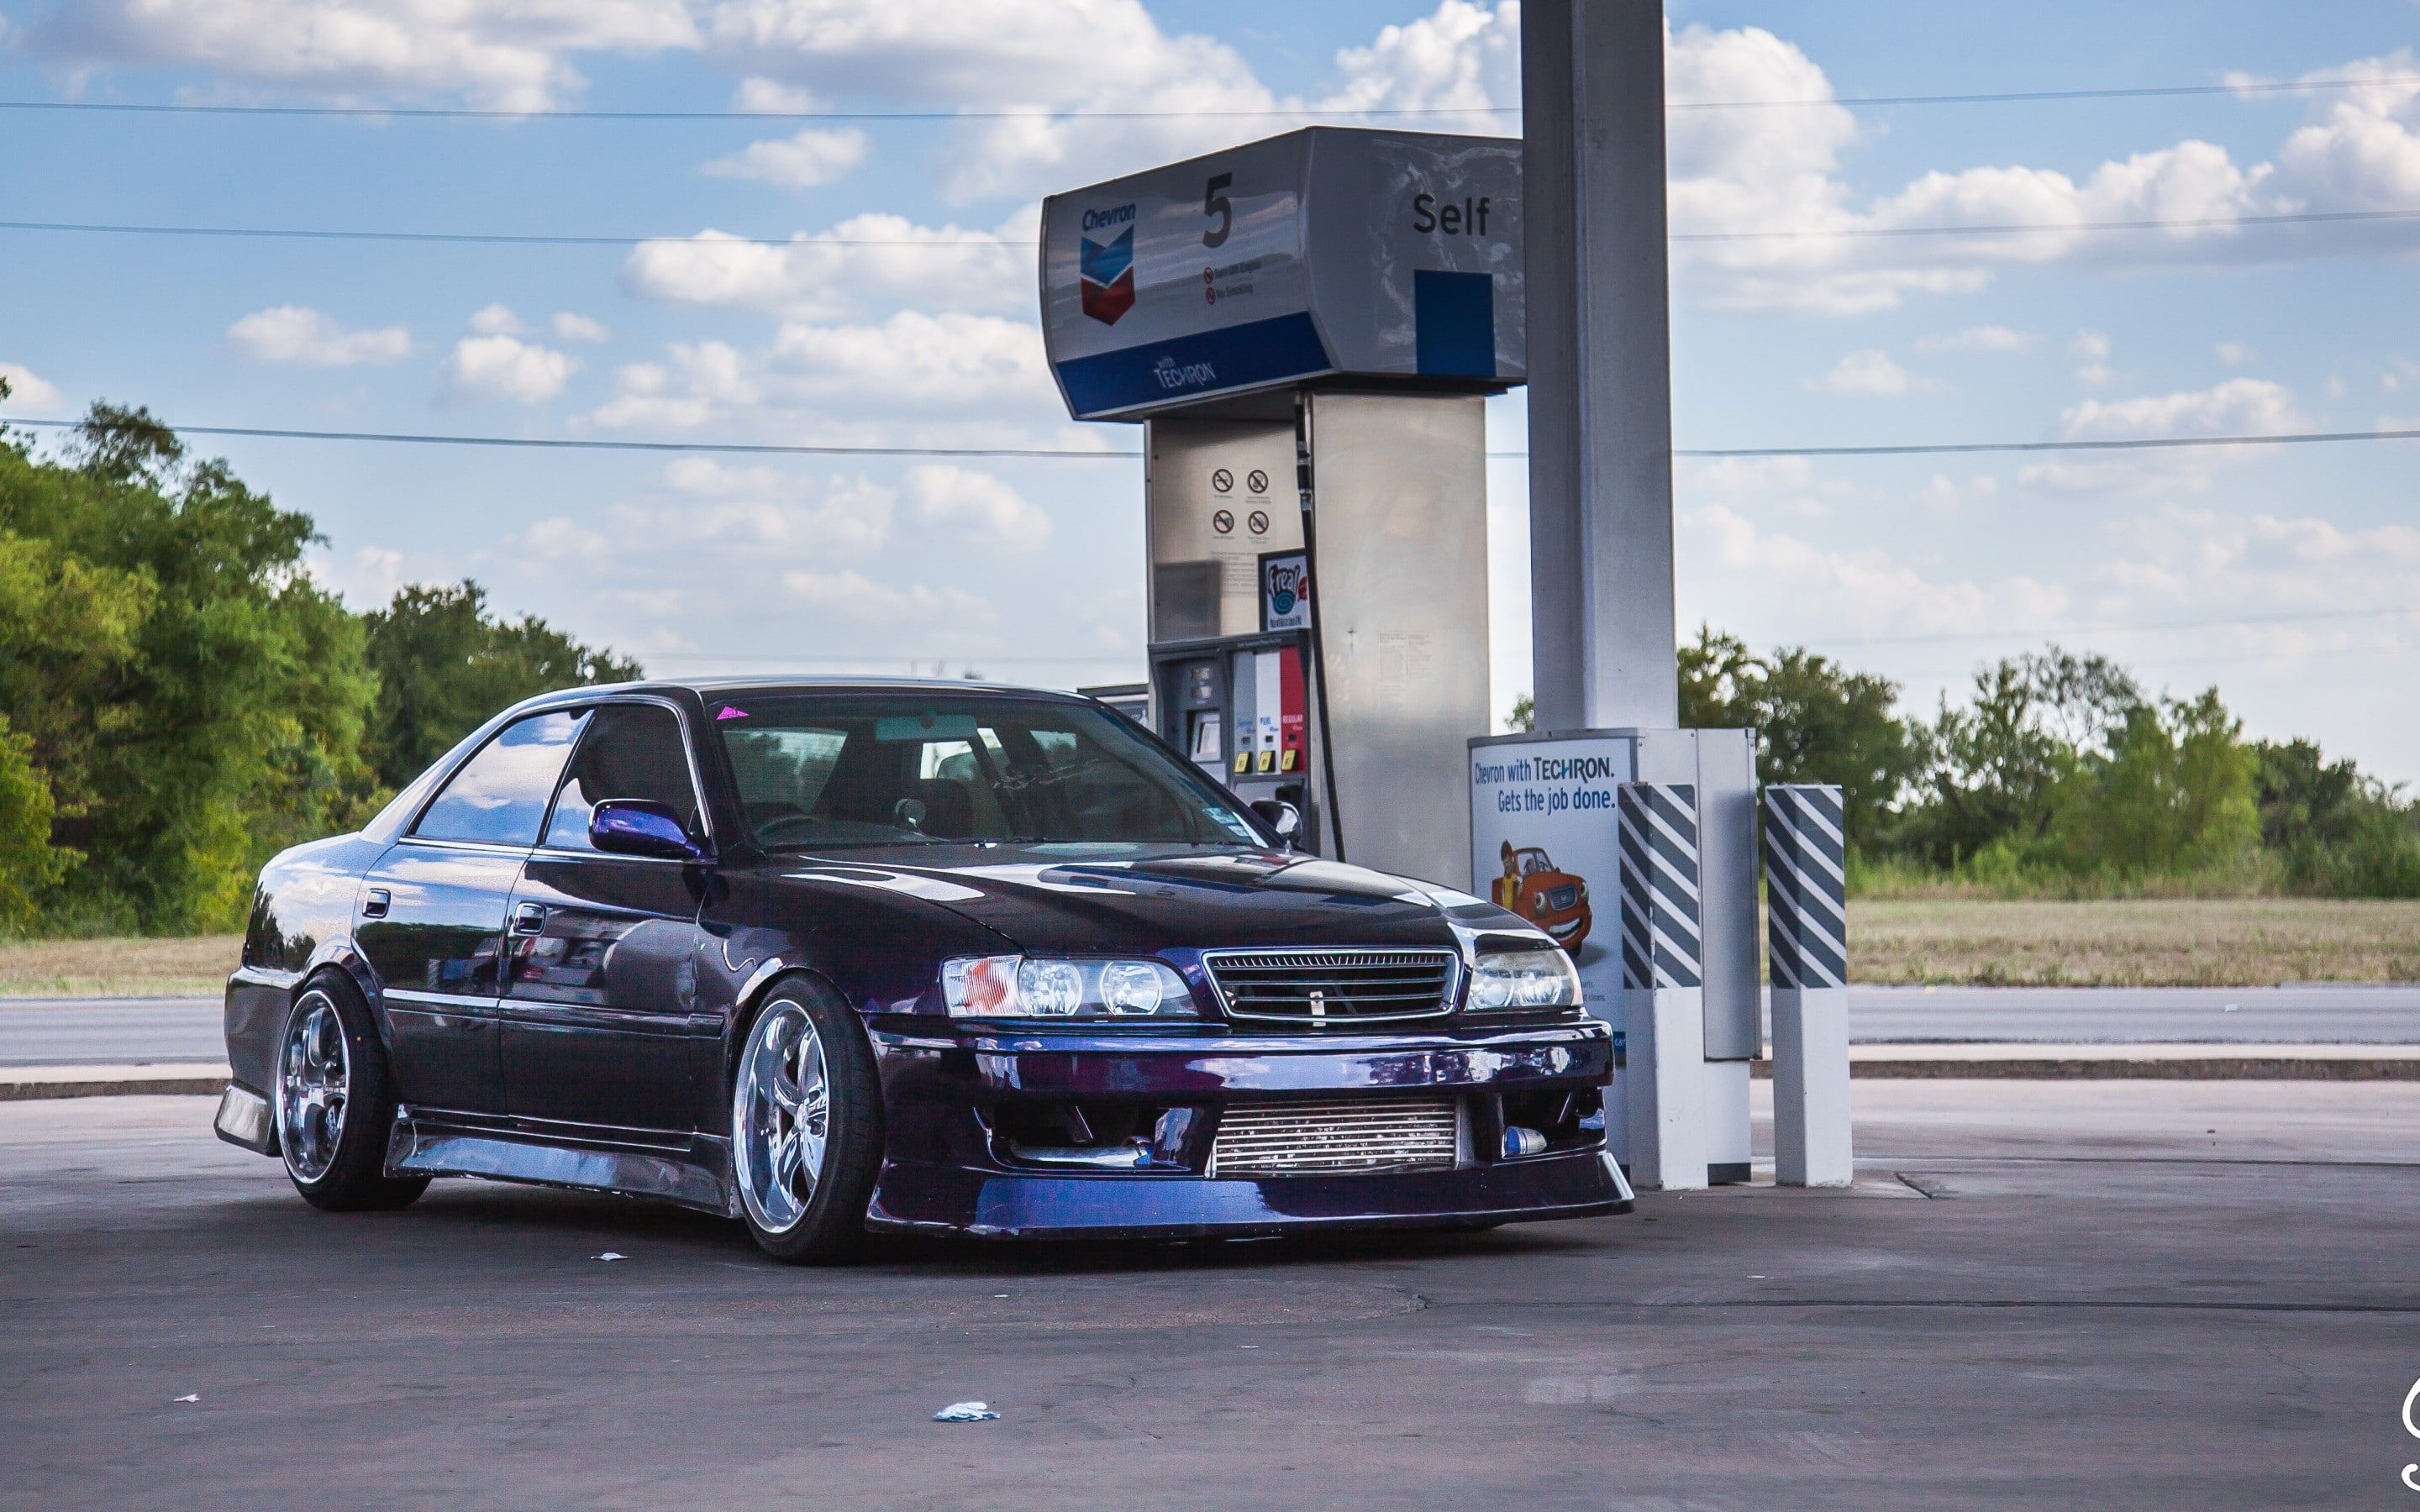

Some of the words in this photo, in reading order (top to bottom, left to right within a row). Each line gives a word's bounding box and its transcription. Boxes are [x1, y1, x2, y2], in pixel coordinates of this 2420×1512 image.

[1081, 203, 1137, 232] Chevron
[1202, 172, 1233, 248] 5
[1413, 193, 1491, 236] Self
[1153, 361, 1217, 388] TECHRON
[1282, 714, 1303, 723] REGULAR
[1475, 762, 1505, 785] Chevron
[1507, 759, 1532, 782] with
[1534, 757, 1615, 784] TECHRON.
[1498, 790, 1522, 812] Gets
[1524, 788, 1544, 811] the
[1547, 786, 1569, 816] job
[1573, 786, 1616, 810] done.
